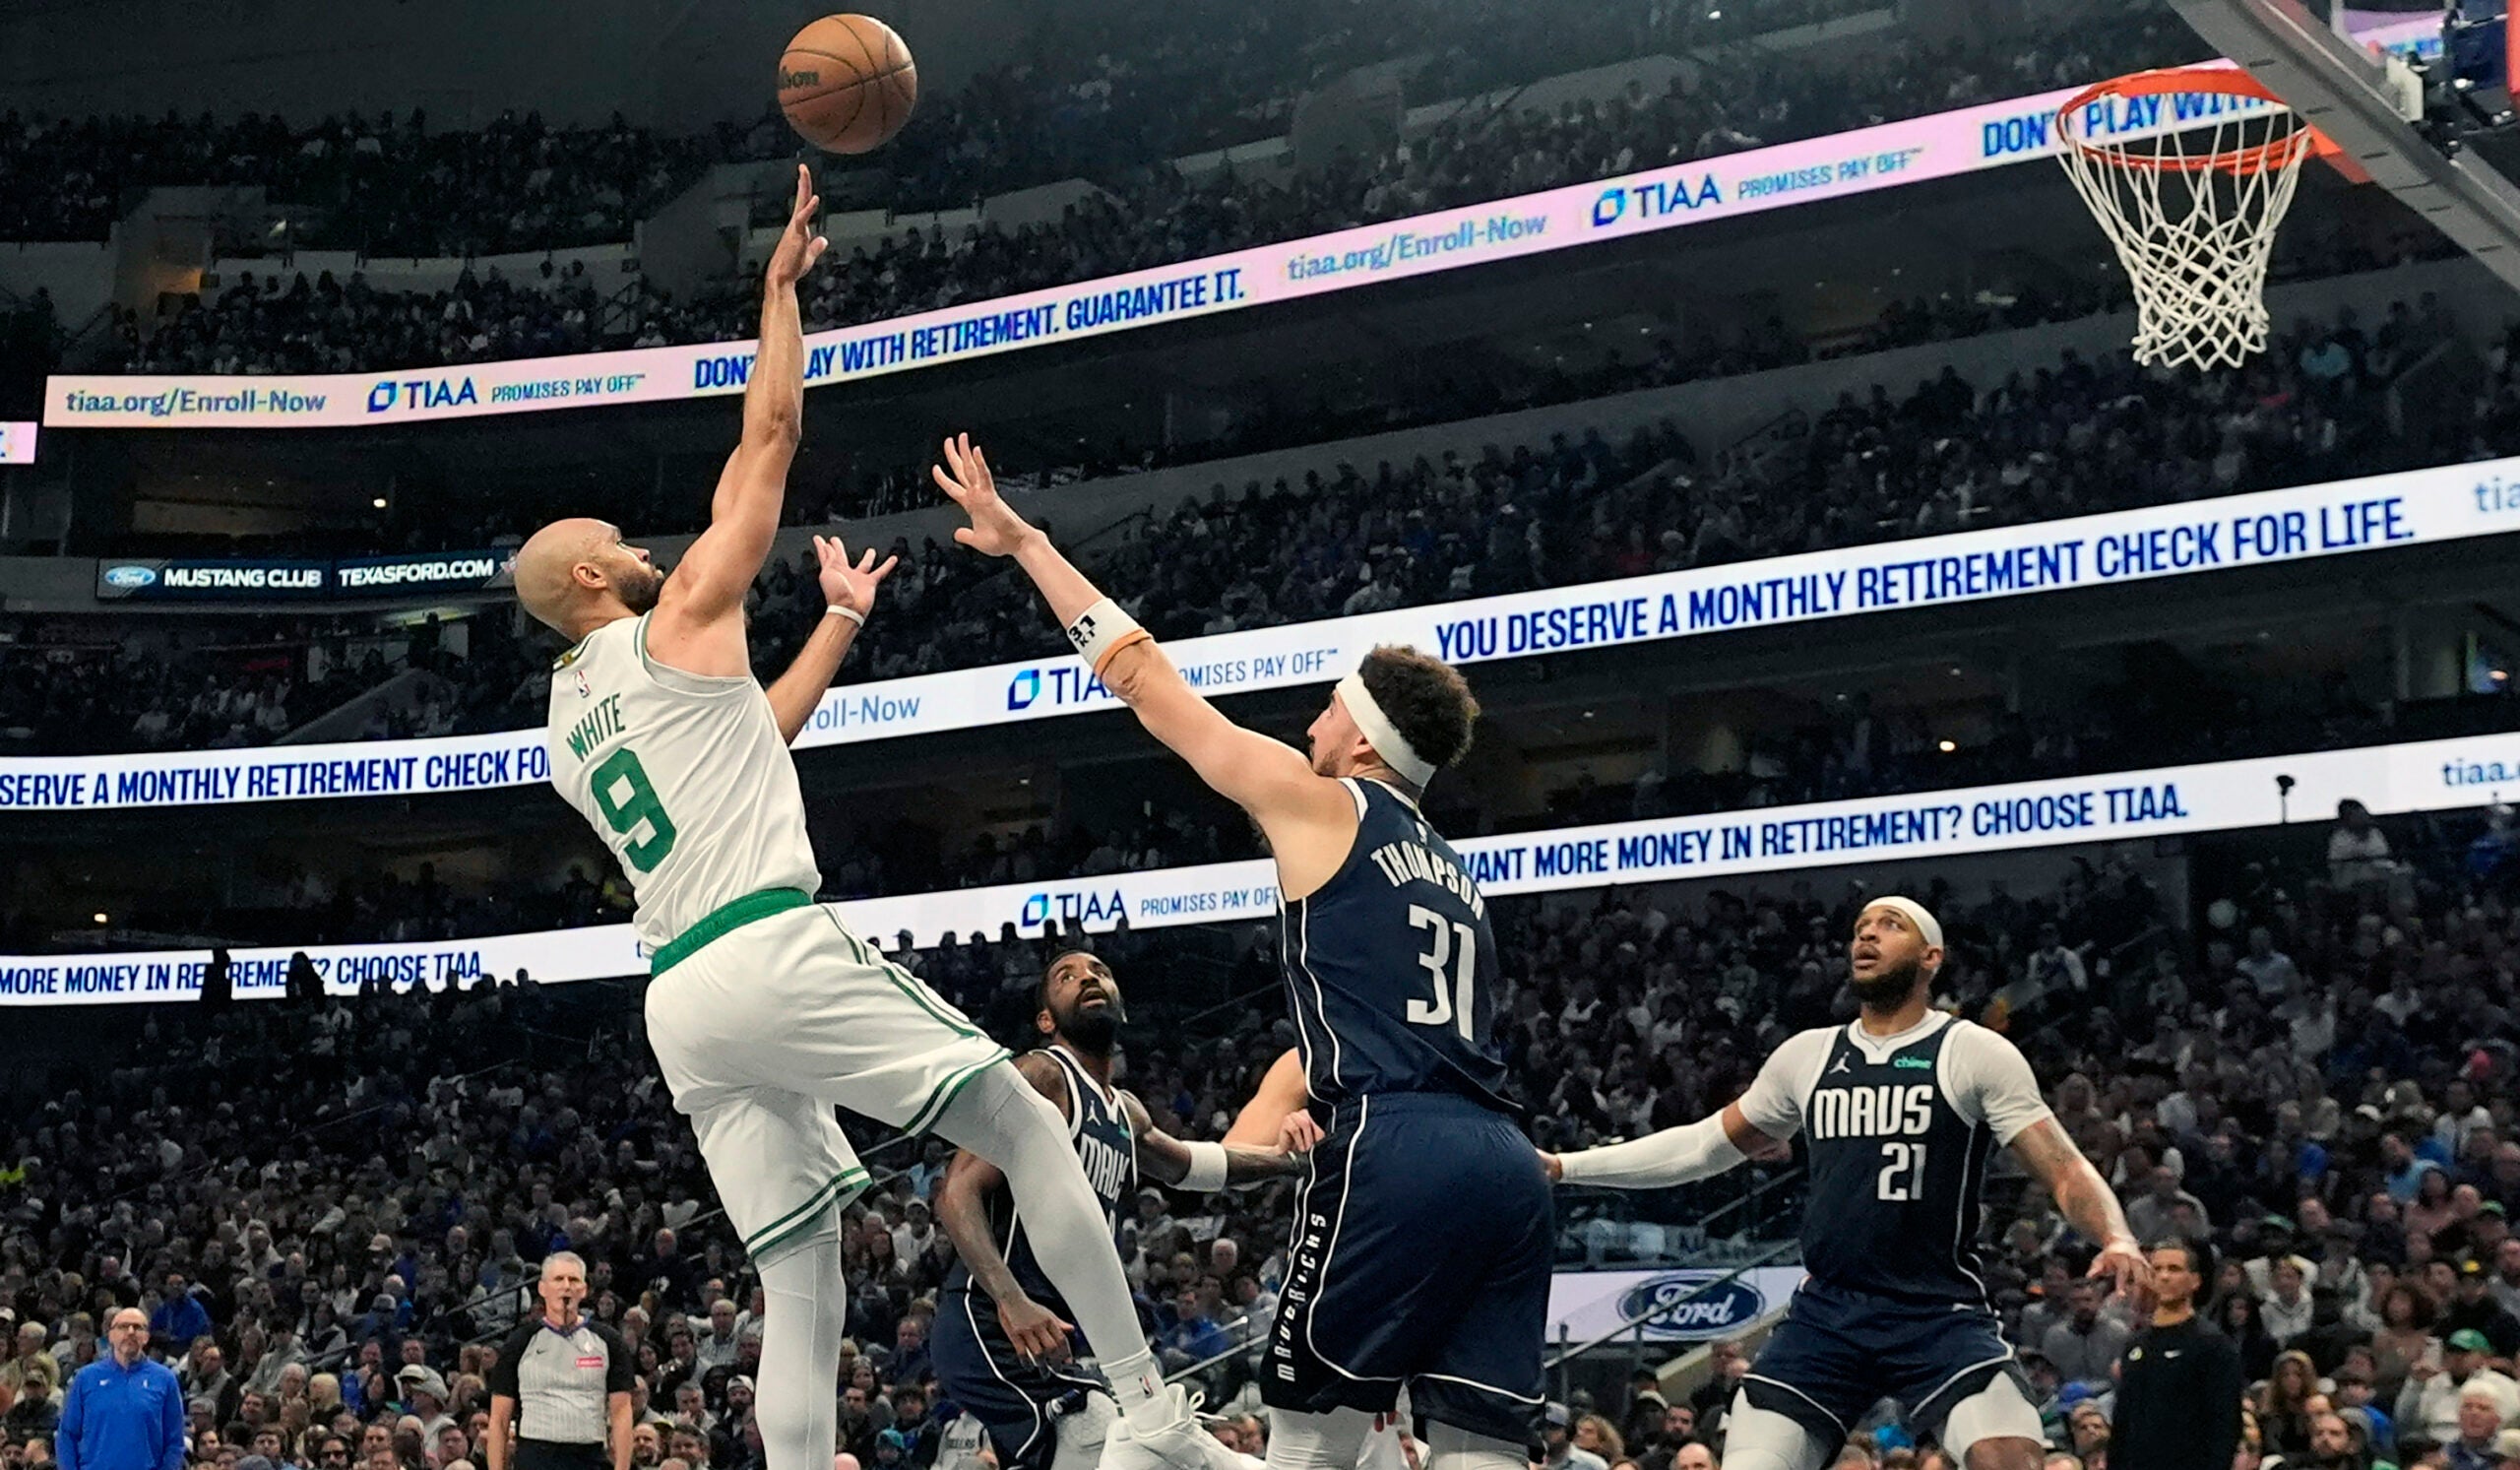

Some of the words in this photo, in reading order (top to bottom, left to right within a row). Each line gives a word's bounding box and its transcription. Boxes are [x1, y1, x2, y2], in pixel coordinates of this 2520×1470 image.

[1288, 212, 1546, 282] tiaa.org/Enroll-Now
[1633, 173, 1723, 219] TIAA
[1738, 164, 1832, 199] PROMISES
[1838, 157, 1871, 181] PAY
[66, 389, 326, 416] tiaa.org/Enroll-Now
[405, 376, 478, 410] TIAA
[491, 380, 571, 403] PROMISES
[575, 377, 602, 395] PAY
[842, 332, 906, 372] WITH
[912, 302, 1059, 358] RETIREMENT.
[1066, 273, 1208, 328] GUARANTEE
[1214, 268, 1245, 302] IT.
[163, 568, 266, 588] MUSTANG
[267, 569, 322, 588] CLUB
[339, 558, 494, 587] TEXASFORD.COM
[1435, 620, 1497, 662] YOU
[1508, 597, 1648, 653] DESERVE
[1658, 594, 1680, 634] A
[1689, 570, 1847, 629] MONTHLY
[1858, 541, 2084, 608] RETIREMENT
[2096, 522, 2220, 577] CHECK
[2234, 510, 2307, 561] FOR
[2321, 497, 2415, 550] LIFE.
[1048, 666, 1114, 706] TIA
[1253, 654, 1286, 679] PAY
[566, 693, 626, 764] WHITE
[93, 773, 109, 804] A
[117, 766, 241, 803] MONTHLY
[247, 757, 418, 799] RETIREMENT
[425, 749, 510, 787] CHECK
[517, 745, 551, 782] FO
[592, 746, 677, 874] 9
[1534, 840, 1608, 877] MORE
[1617, 829, 1712, 869] MONEY
[1721, 825, 1752, 860] IN
[1761, 805, 1964, 856] RETIREMENT?
[1972, 793, 2094, 837] CHOOSE
[2105, 784, 2189, 824] TIAA.
[1055, 889, 1128, 924] TIAA
[1140, 892, 1217, 918] PROMISES
[1223, 889, 1249, 909] PAY
[1370, 840, 1484, 921] THOMPSON
[64, 965, 141, 993] MONEY
[146, 963, 169, 990] IN
[337, 954, 427, 985] CHOOSE
[1406, 903, 1479, 1042] 31
[1813, 1084, 1932, 1140] MAVS
[1877, 1142, 1925, 1201] 21
[1646, 1282, 1736, 1325] Ford
